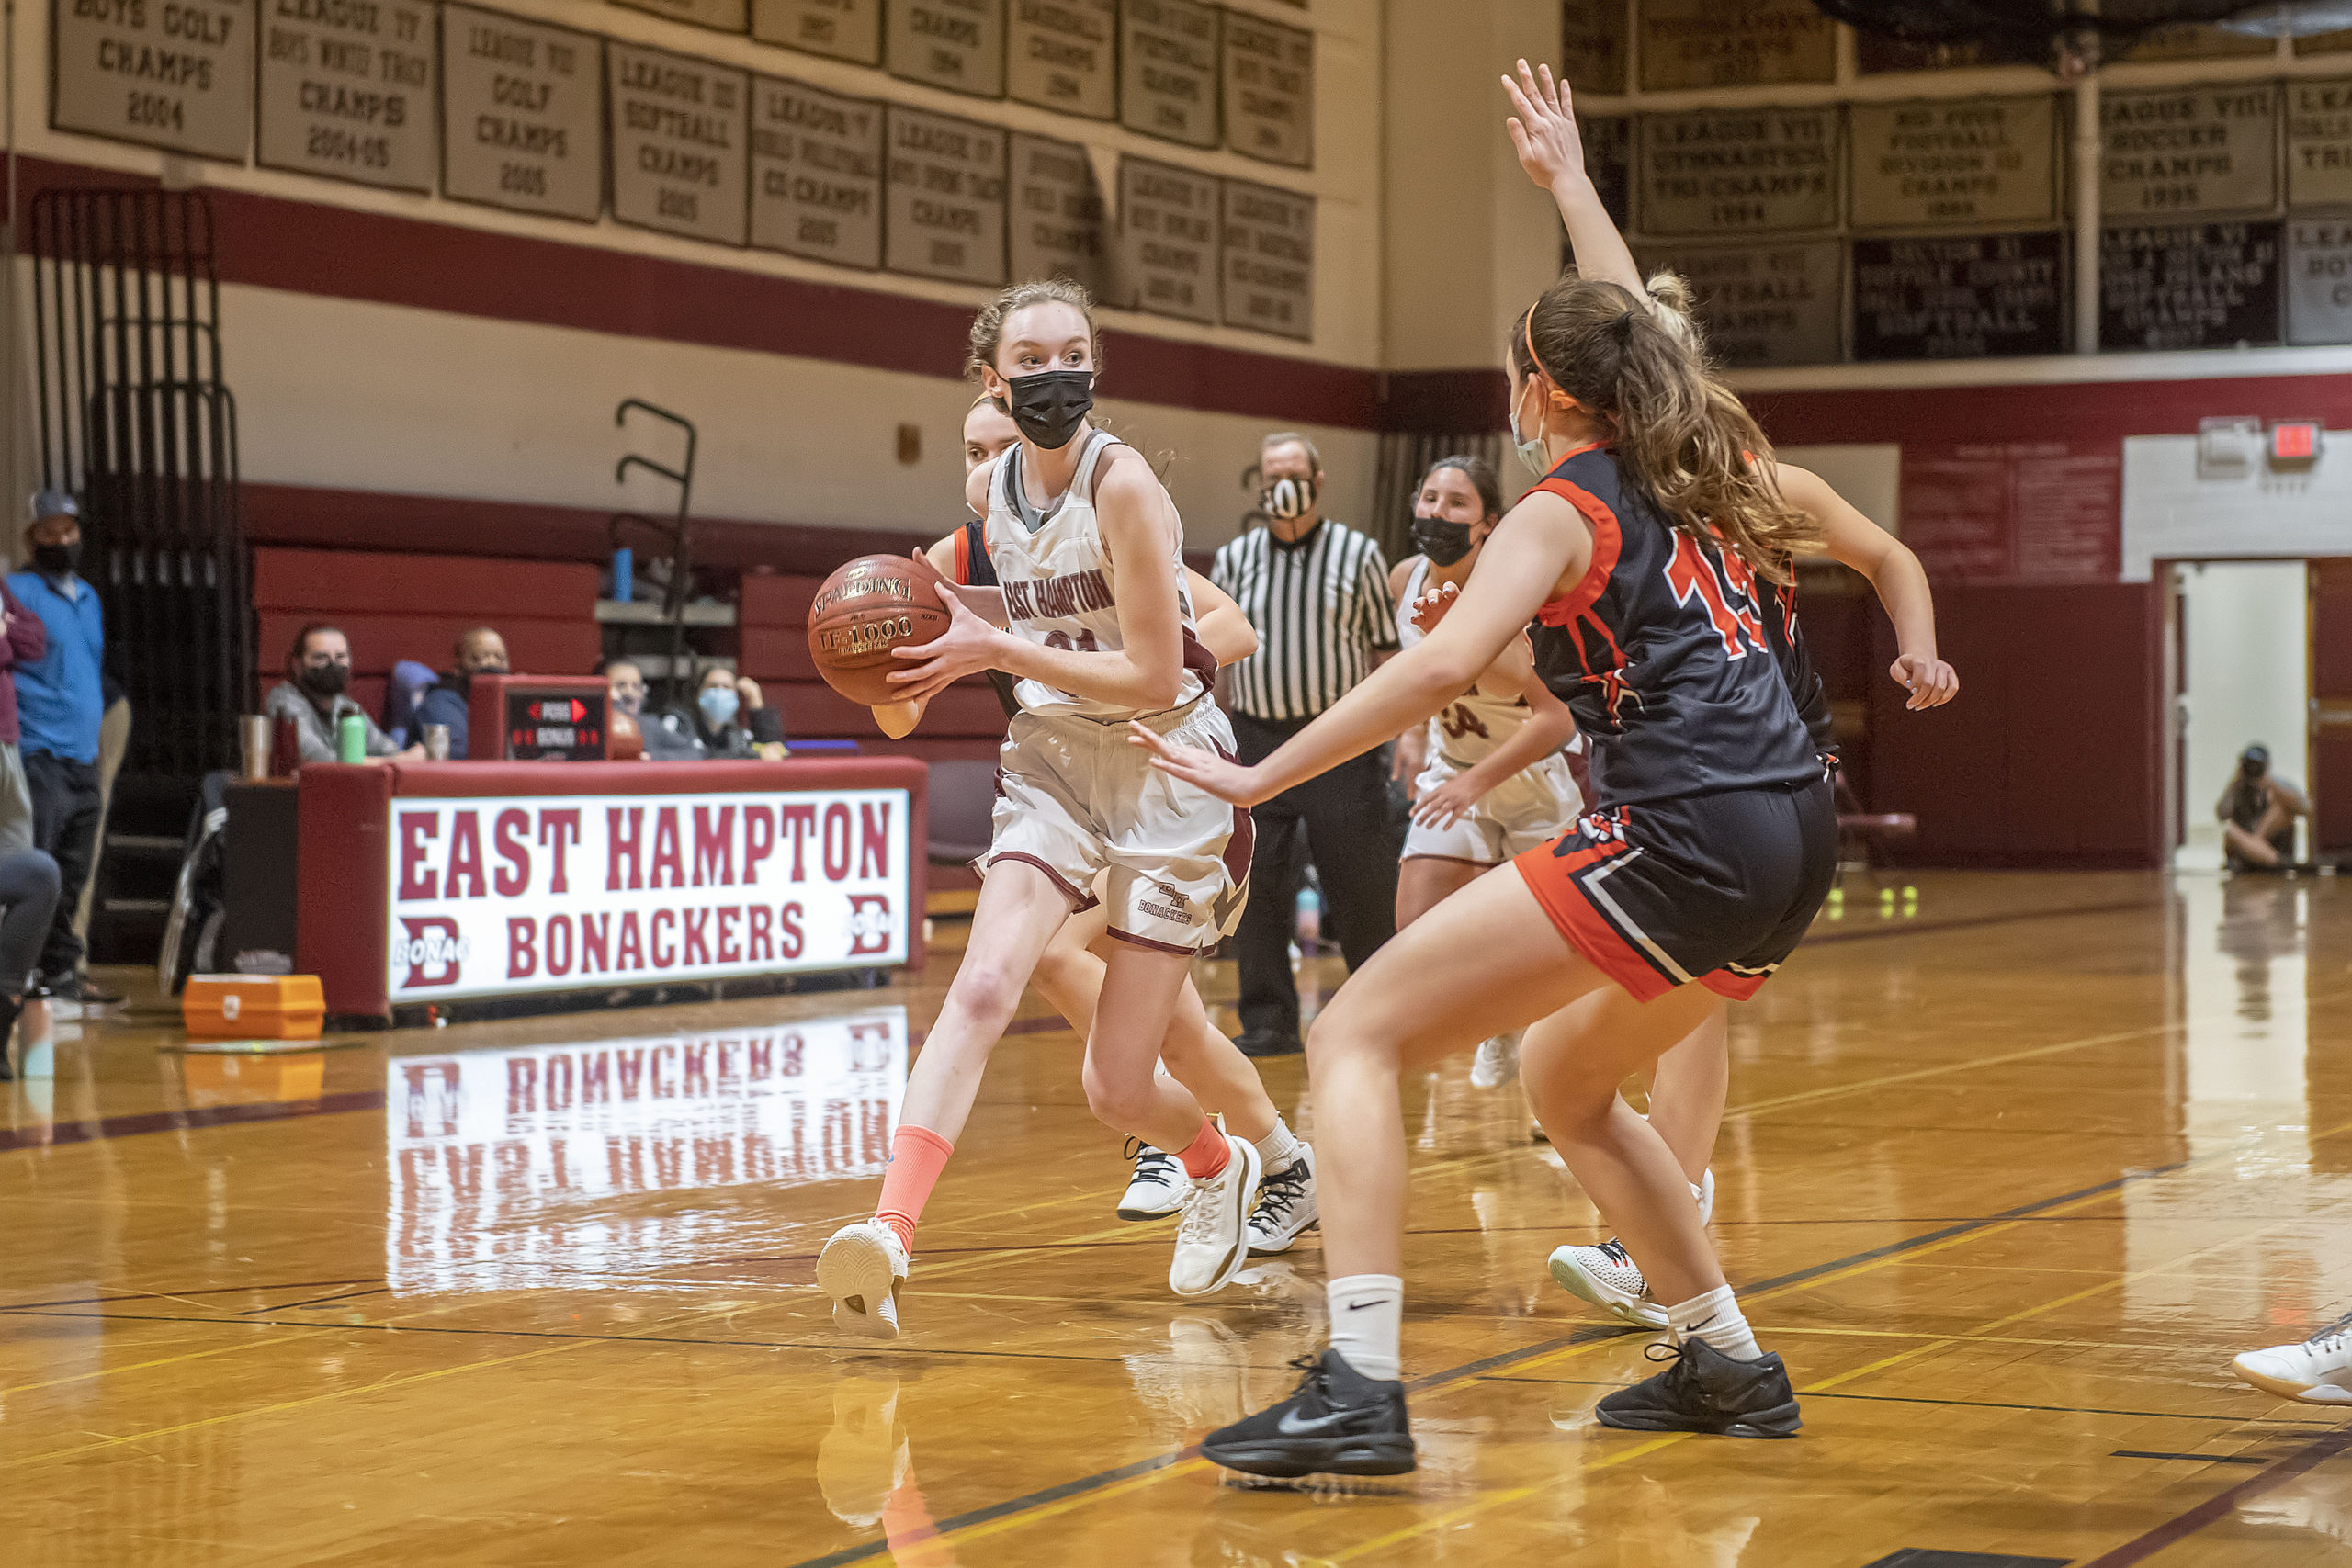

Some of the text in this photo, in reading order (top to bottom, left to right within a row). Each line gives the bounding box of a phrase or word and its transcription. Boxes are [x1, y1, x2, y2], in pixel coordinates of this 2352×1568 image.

[164, 4, 233, 47] GOLF
[277, 0, 379, 34] LEAGUE
[98, 37, 214, 91] CHAMPS
[469, 25, 535, 69] LEAGUE
[492, 73, 551, 112] GOLF
[621, 59, 704, 103] LEAGUE
[128, 92, 184, 130] 2004
[300, 81, 406, 127] CHAMPS
[624, 98, 731, 150] SOFTBALL
[476, 115, 568, 158] CHAMPS
[639, 144, 719, 187] CHAMPS
[2105, 152, 2233, 184] CHAMPS
[814, 577, 910, 621] SPALDING
[1032, 568, 1115, 618] HAMPTON
[398, 802, 891, 901] EAST HAMPTON
[1138, 899, 1193, 925] BONACKERS
[507, 902, 805, 979] BONACKERS
